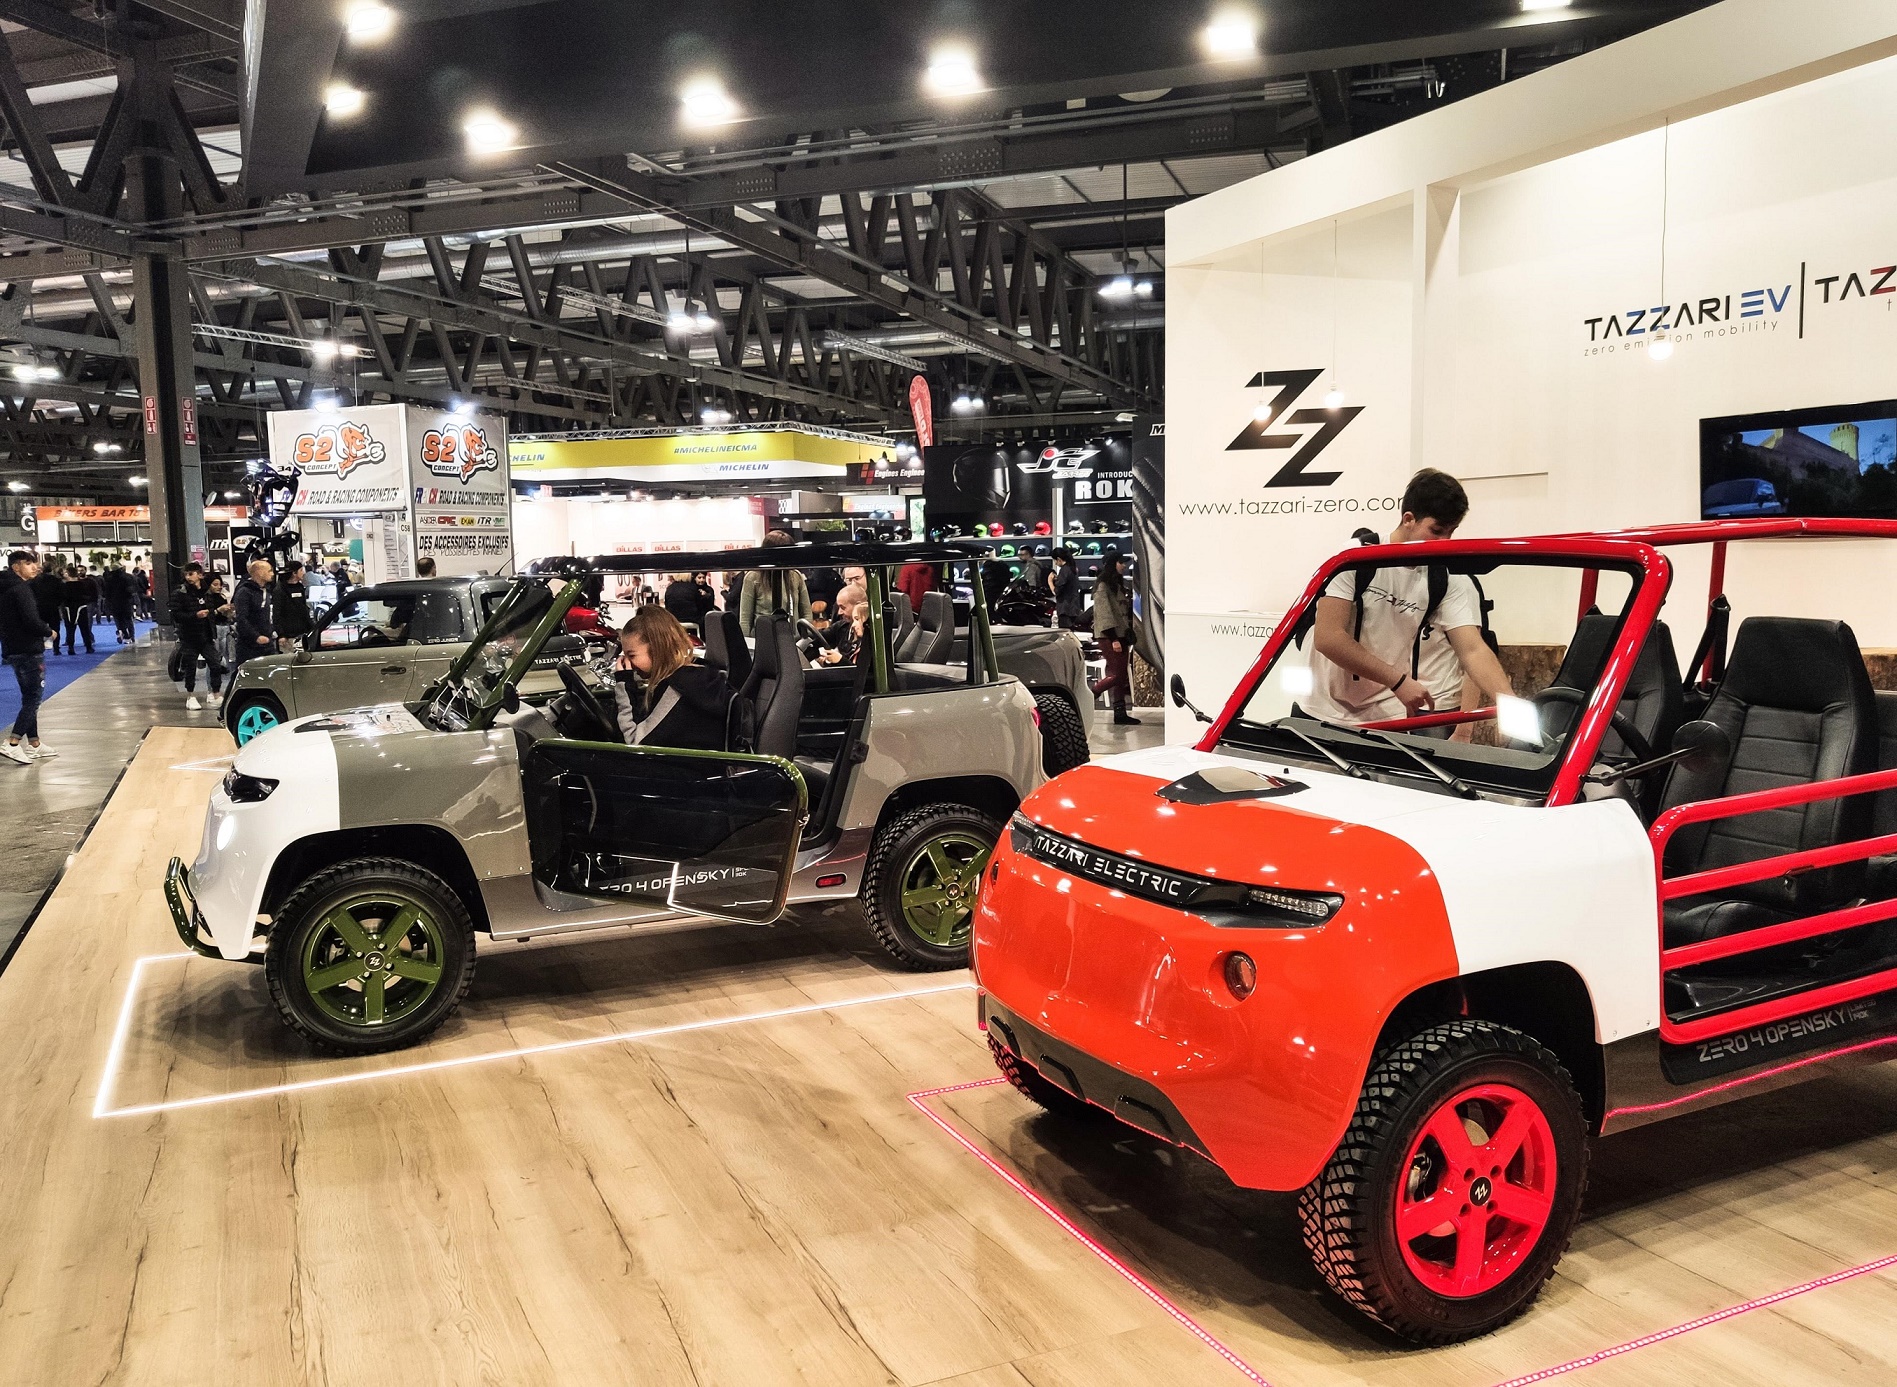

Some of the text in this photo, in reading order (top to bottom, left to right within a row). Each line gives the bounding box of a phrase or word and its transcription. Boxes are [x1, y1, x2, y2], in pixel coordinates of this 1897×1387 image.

[1584, 285, 1792, 341] TAZZARI EV
[1584, 319, 1778, 357] zero emiion mobility
[297, 437, 333, 463] S2
[424, 434, 456, 462] S2
[674, 445, 757, 454] #MICHELINEICMA
[510, 454, 545, 462] HELIN
[307, 463, 337, 471] CONCEPT
[719, 464, 769, 472] MICHELIN
[101, 509, 125, 517] BAR
[478, 516, 492, 525] ITR
[21, 515, 36, 531] G
[210, 539, 229, 550] ITR
[419, 535, 508, 549] DES ACCESSOIRES EXCLUSIFS
[1211, 622, 1276, 638] www.tazza
[1036, 835, 1182, 897] TAZZARI ELECTRIC
[636, 880, 648, 891] 4
[651, 869, 730, 891] OPENSKY
[1696, 1006, 1846, 1062] ZERO 4 OPENSKY
